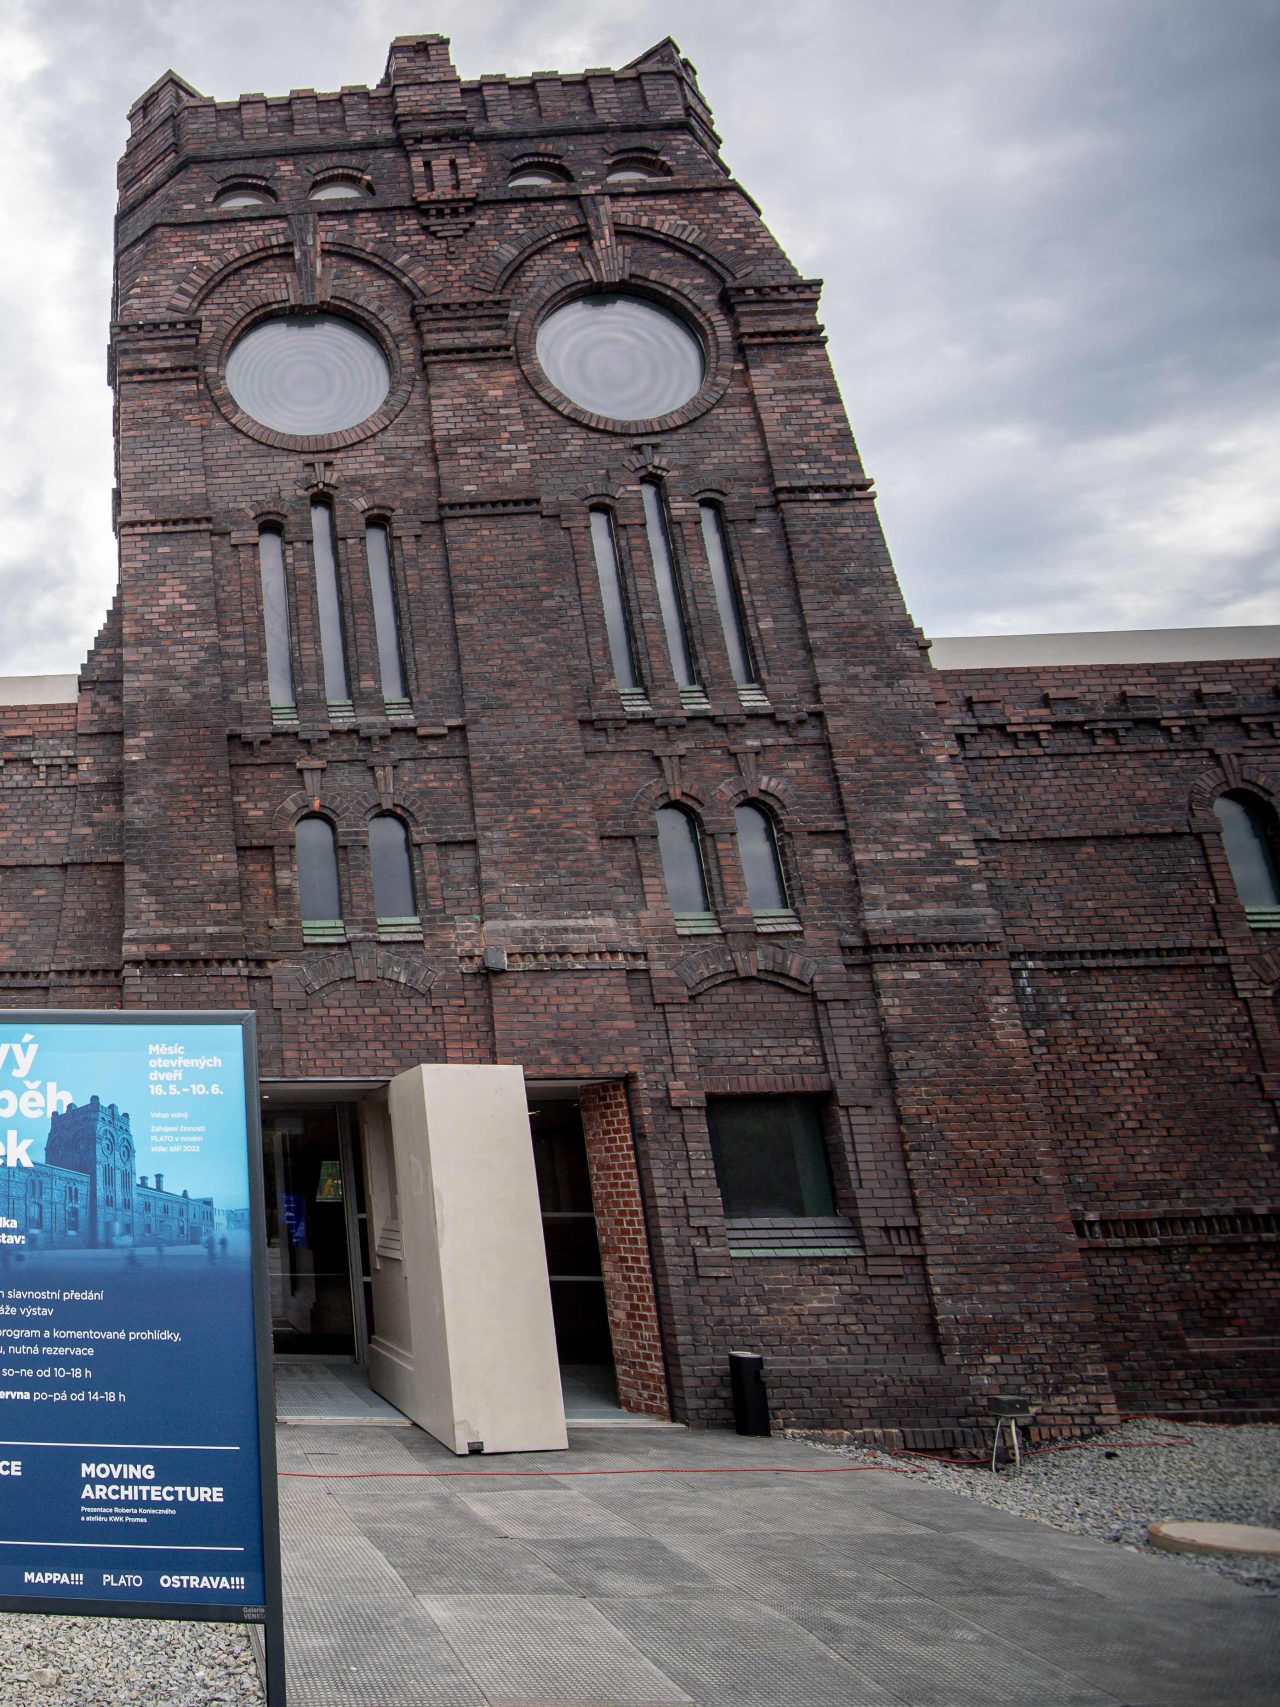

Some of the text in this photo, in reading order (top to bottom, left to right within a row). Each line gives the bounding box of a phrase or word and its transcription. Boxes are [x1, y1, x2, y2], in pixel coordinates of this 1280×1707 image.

[148, 1043, 185, 1055] Měsíc
[148, 1056, 222, 1069] otevřených
[148, 1069, 183, 1080] dveří
[149, 1084, 167, 1096] 16.
[168, 1084, 181, 1096] 5.
[211, 1083, 224, 1095] 6.
[7, 1288, 61, 1300] slavnostní
[63, 1290, 104, 1302] předání
[20, 1306, 54, 1317] výstav
[43, 1330, 50, 1338] a
[53, 1328, 126, 1340] komentované
[128, 1329, 182, 1342] prohlídky,
[8, 1345, 39, 1355] nutná
[42, 1346, 95, 1356] rezervace
[36, 1367, 51, 1377] od
[84, 1368, 92, 1378] h
[70, 1391, 85, 1401] od
[118, 1392, 126, 1402] h
[81, 1463, 155, 1479] MOVING
[81, 1484, 224, 1502] ARCHITECTURE
[80, 1506, 113, 1514] Prezentace
[24, 1571, 84, 1585] MAPPA!!!
[102, 1574, 143, 1587] PLATO
[159, 1575, 245, 1590] OSTRAVA!!!
